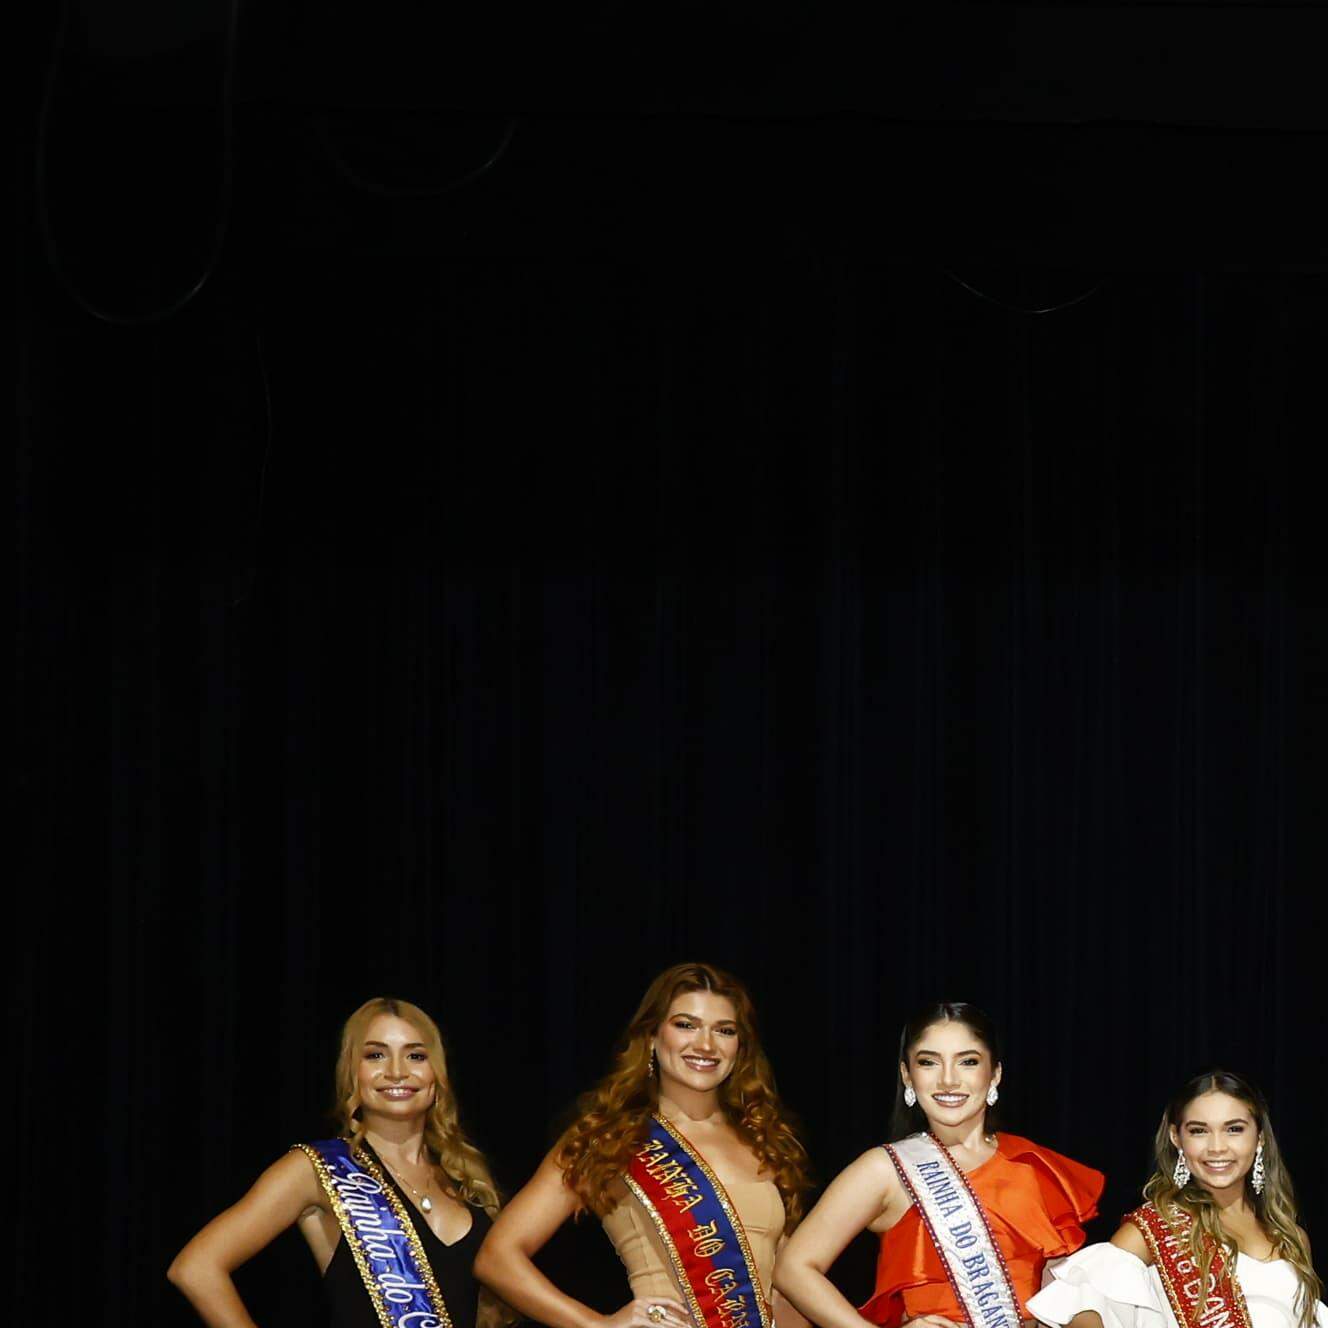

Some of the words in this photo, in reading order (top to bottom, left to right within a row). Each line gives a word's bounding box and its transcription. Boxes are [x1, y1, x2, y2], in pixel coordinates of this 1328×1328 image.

[327, 1165, 405, 1260] Rainha
[378, 1273, 425, 1303] do
[688, 1219, 726, 1258] DO
[916, 1161, 962, 1218] RAINHA
[950, 1222, 977, 1250] DO
